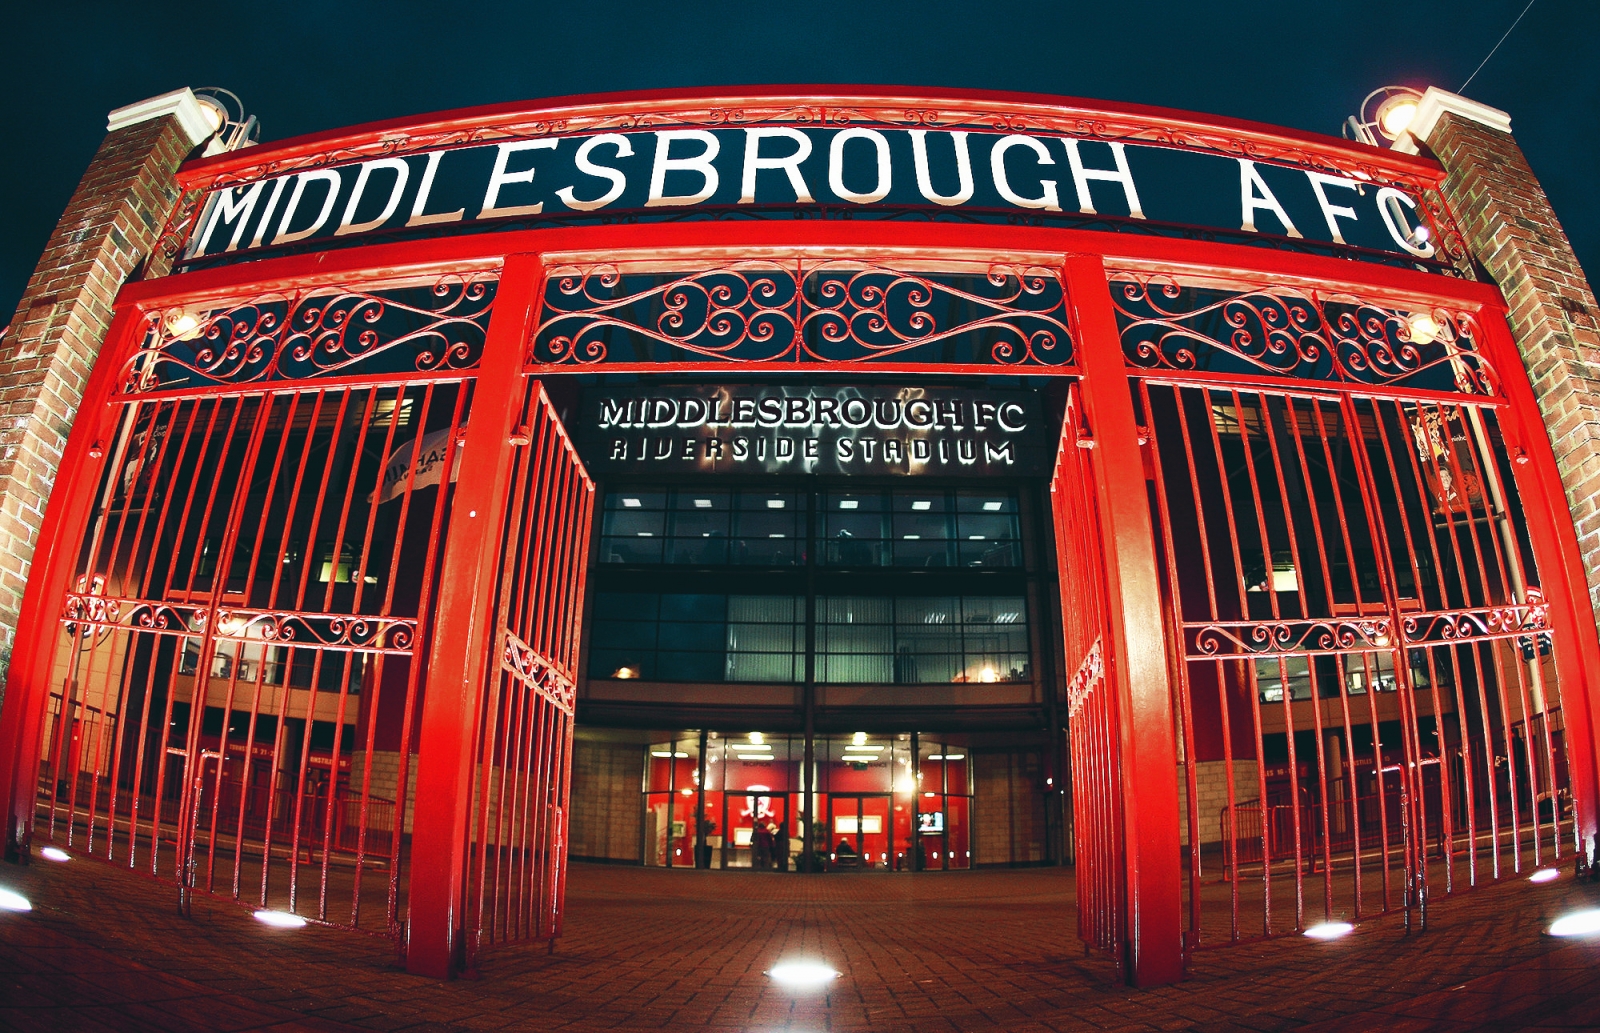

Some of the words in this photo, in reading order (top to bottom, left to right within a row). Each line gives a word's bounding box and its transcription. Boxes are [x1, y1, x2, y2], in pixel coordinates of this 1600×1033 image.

[193, 125, 1147, 258] MIDDLESBROUGH
[1236, 157, 1435, 259] AFC
[598, 397, 964, 431] MIDDLESBROUGH
[973, 400, 1027, 432] FC
[609, 436, 819, 462] RIVERSIDE
[836, 438, 1015, 465] STADIUM
